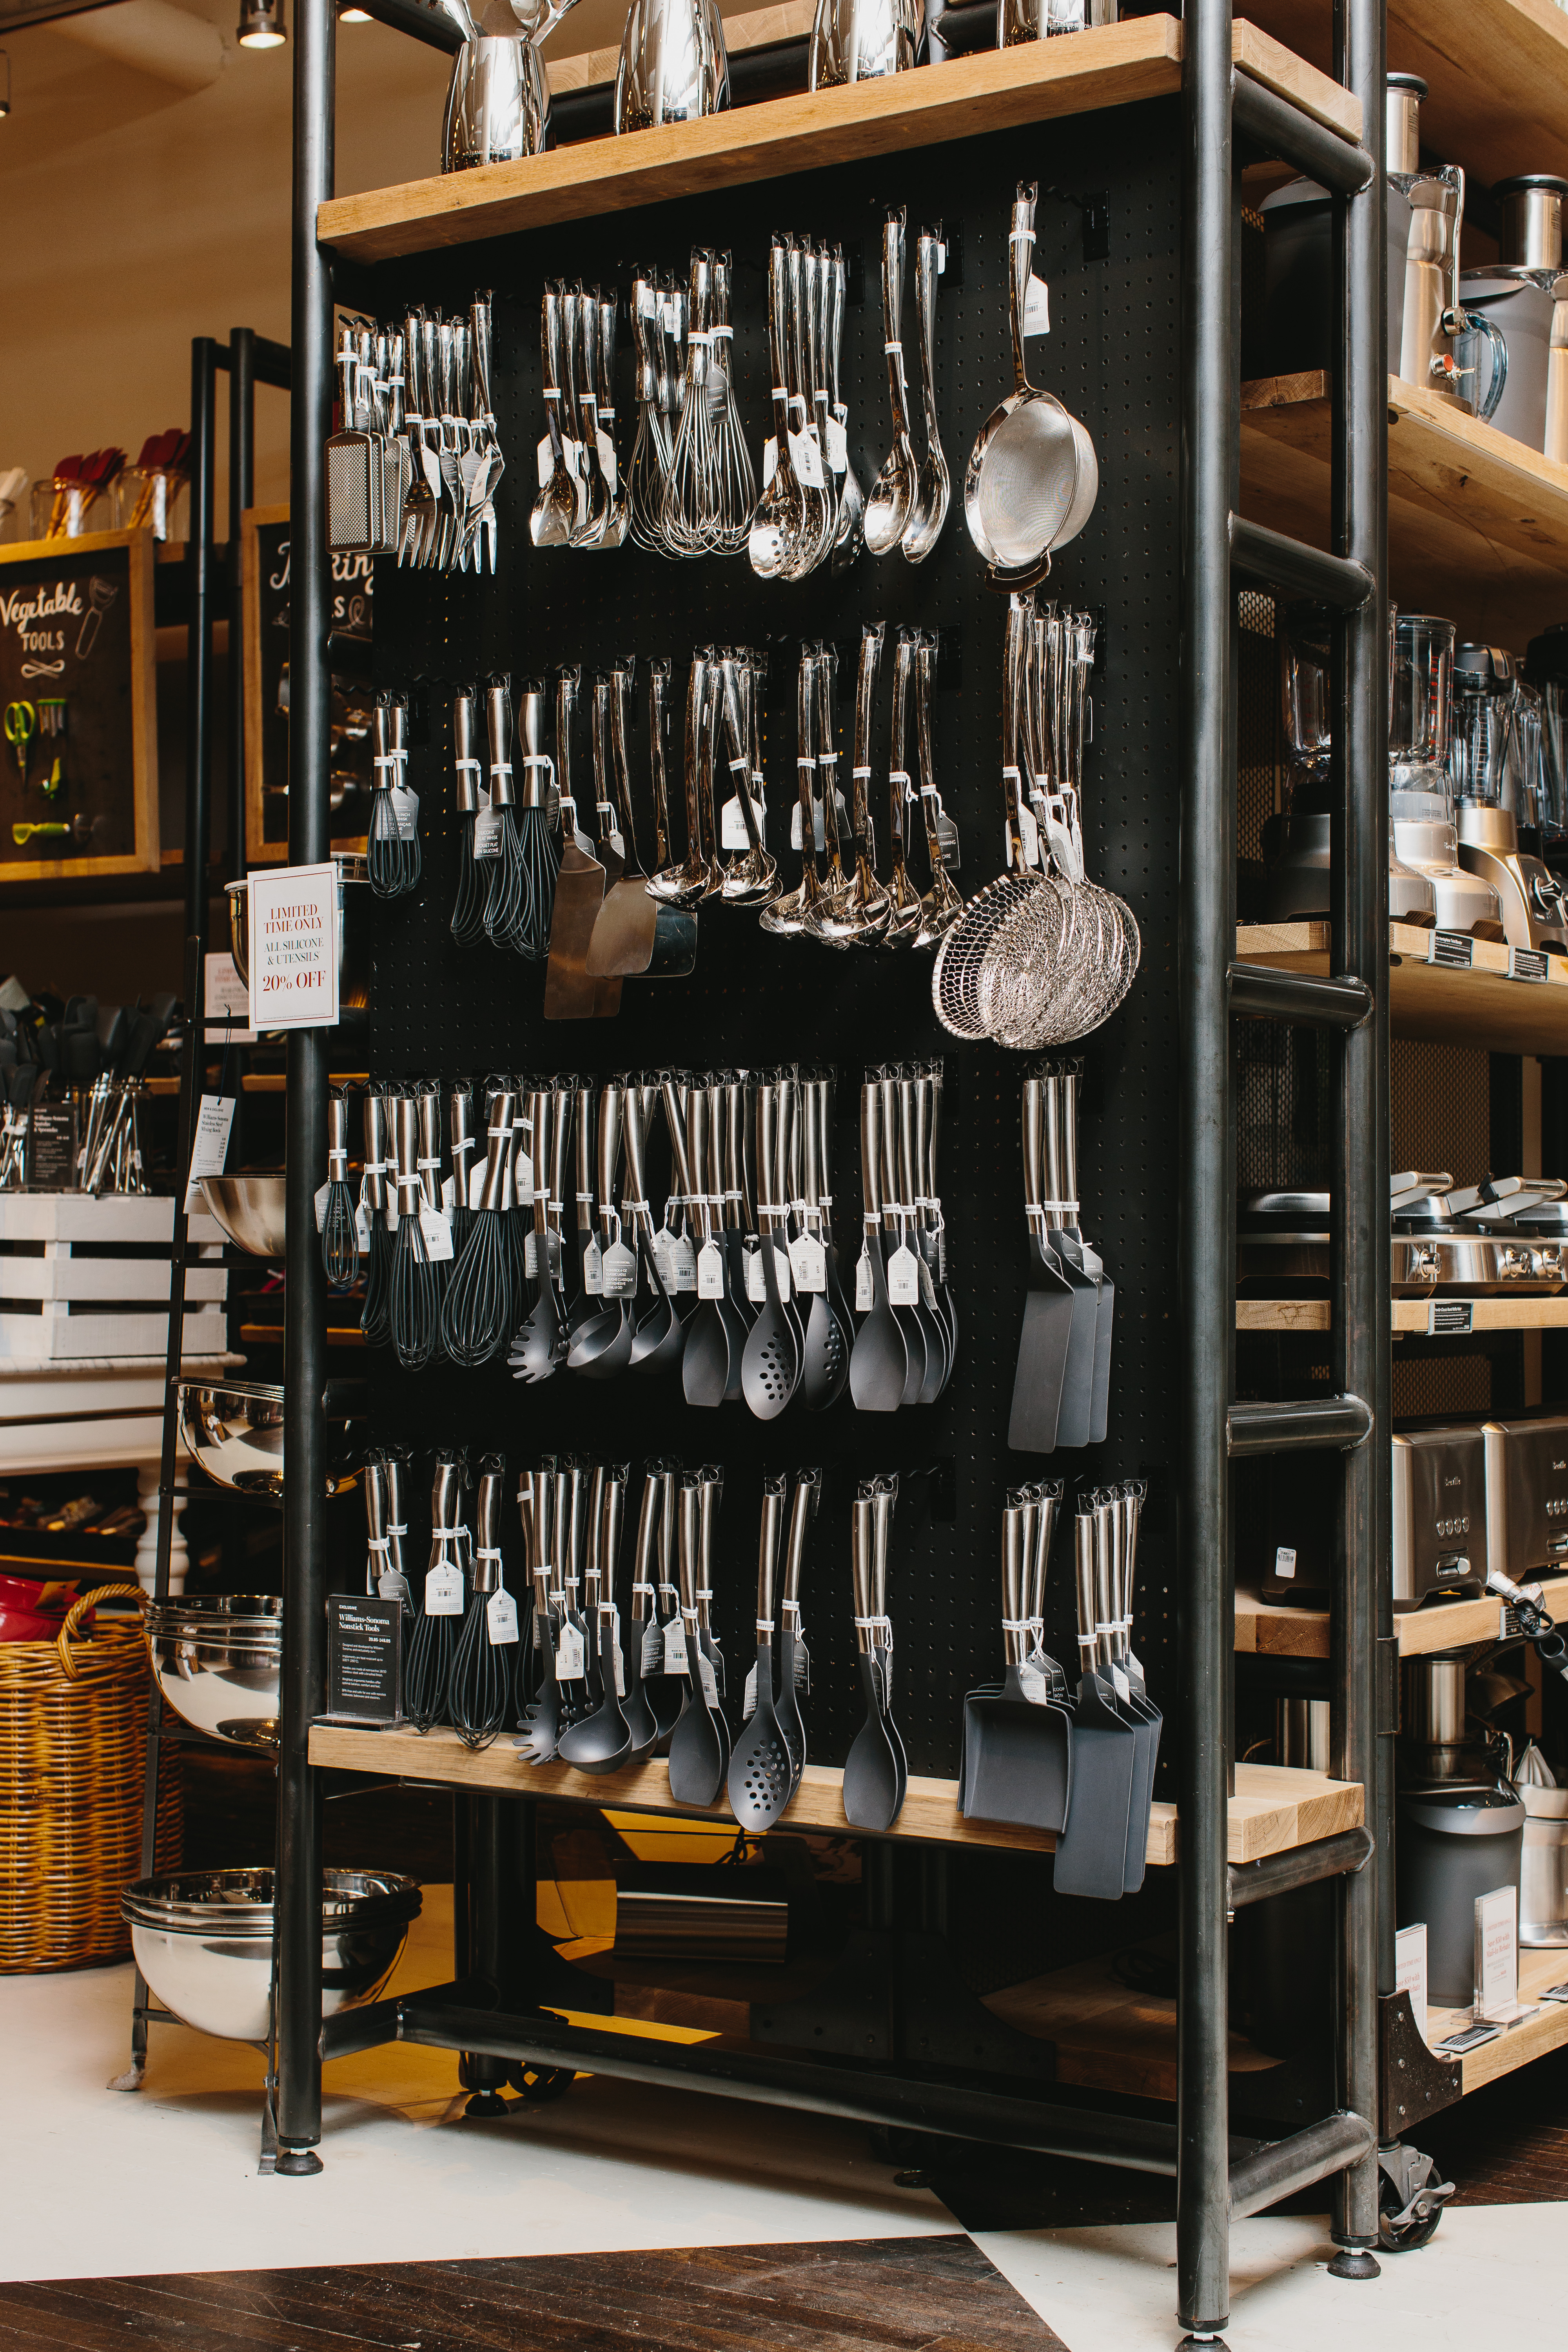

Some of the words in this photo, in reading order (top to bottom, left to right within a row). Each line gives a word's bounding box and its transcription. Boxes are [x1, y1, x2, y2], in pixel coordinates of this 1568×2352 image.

[0, 582, 83, 634] Vegetable
[20, 630, 65, 653] TOOLS
[270, 904, 318, 920] LIMITED
[263, 920, 292, 934] TIME
[295, 916, 324, 931] ONLY
[264, 942, 281, 953] ALL
[283, 937, 324, 951] SILICONE
[267, 955, 274, 965] &
[263, 974, 292, 992] 20%
[296, 970, 326, 989] OFF
[339, 1613, 390, 1625] Williams-Sonoma
[339, 1622, 364, 1631] Nonstick
[1412, 1972, 1420, 1982] with
